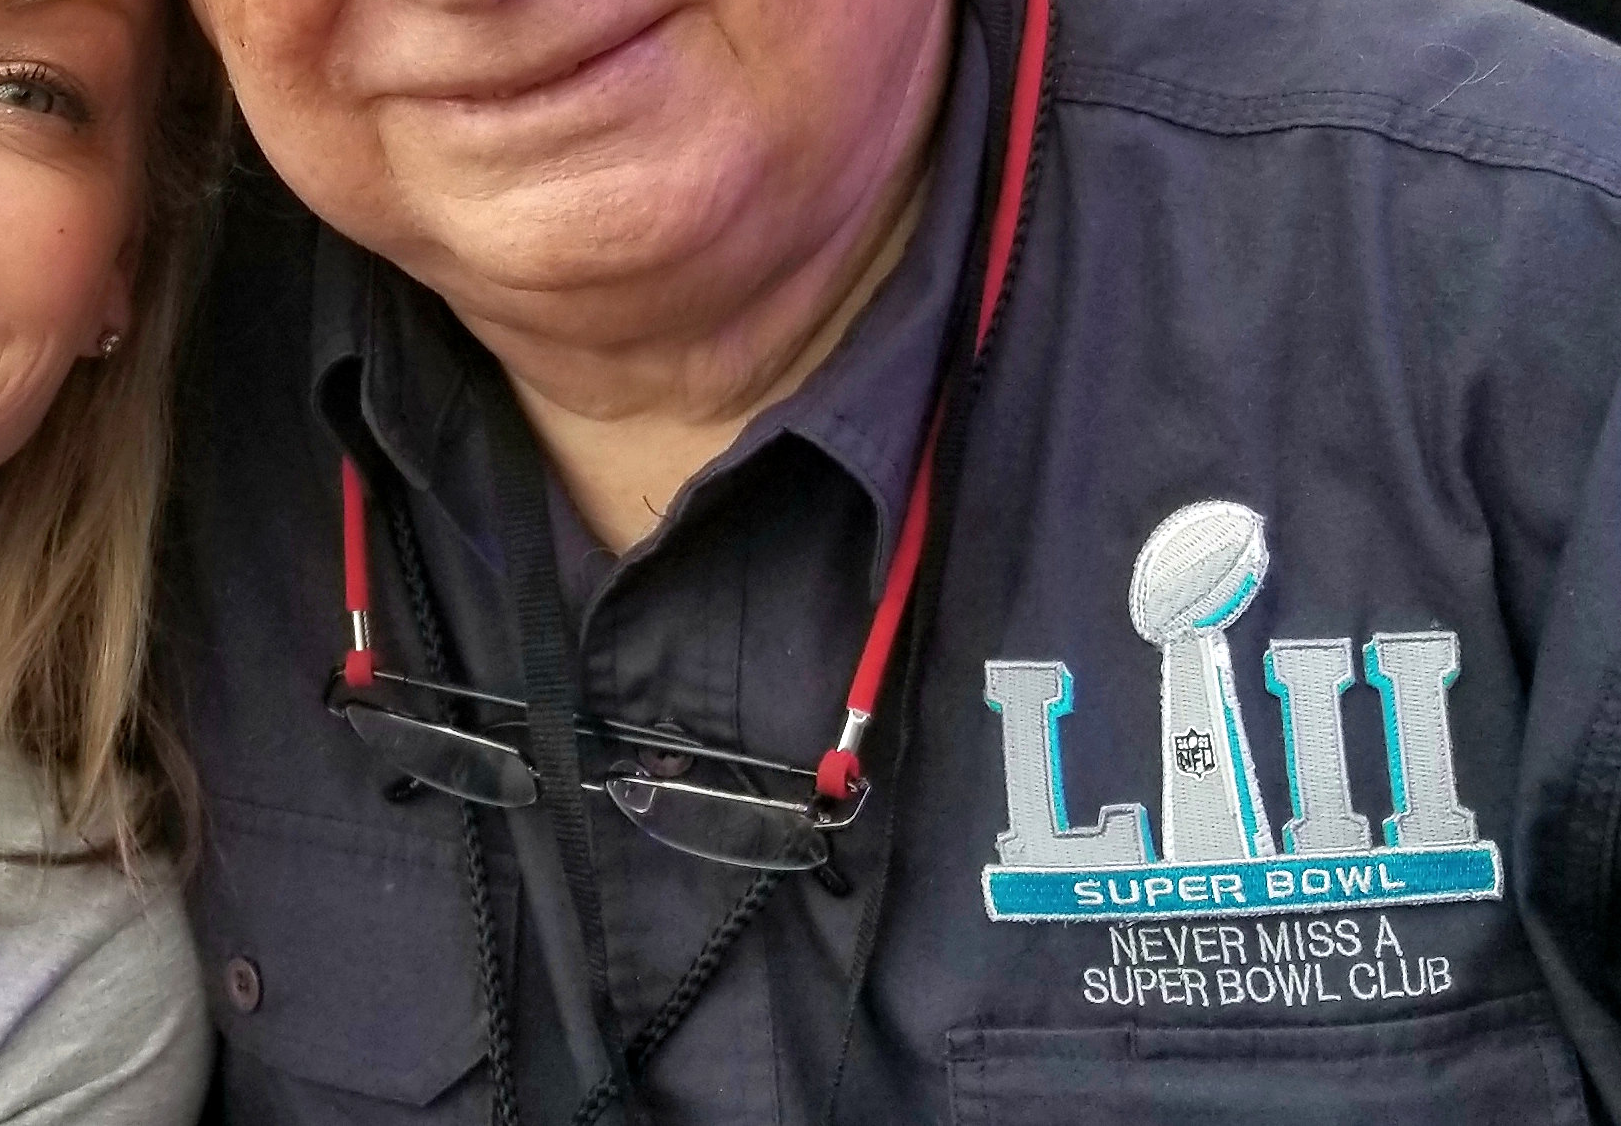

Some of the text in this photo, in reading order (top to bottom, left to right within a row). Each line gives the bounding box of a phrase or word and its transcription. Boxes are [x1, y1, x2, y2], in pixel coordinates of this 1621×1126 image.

[1177, 749, 1216, 772] NFL
[1073, 863, 1407, 907] SUPER BOWL
[1108, 914, 1405, 967] NEVER MISS A
[1082, 956, 1453, 1008] SUPER BOWL CLUB
